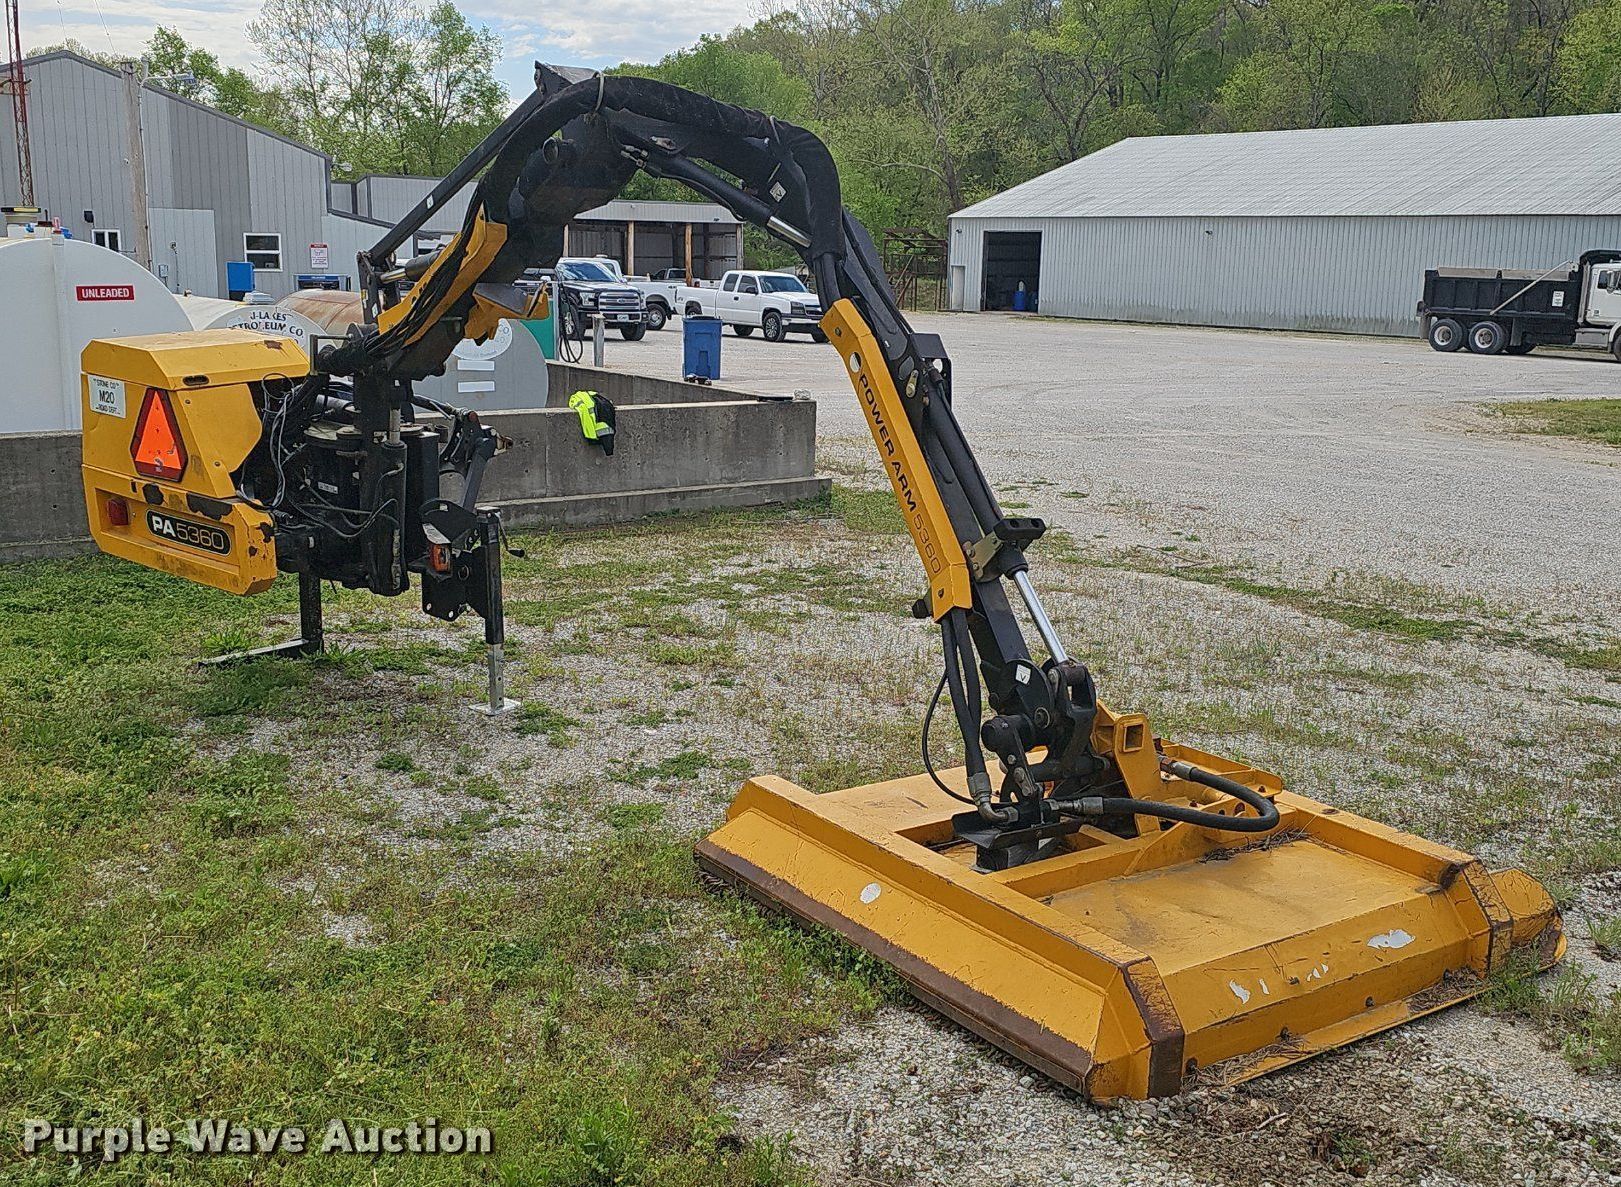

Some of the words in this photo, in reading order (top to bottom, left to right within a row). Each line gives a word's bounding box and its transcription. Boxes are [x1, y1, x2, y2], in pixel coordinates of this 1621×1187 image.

[81, 288, 130, 298] UNLEADED
[99, 389, 115, 404] M20
[861, 374, 895, 457] POWER
[891, 460, 917, 512] ARM
[913, 513, 941, 574] 5360
